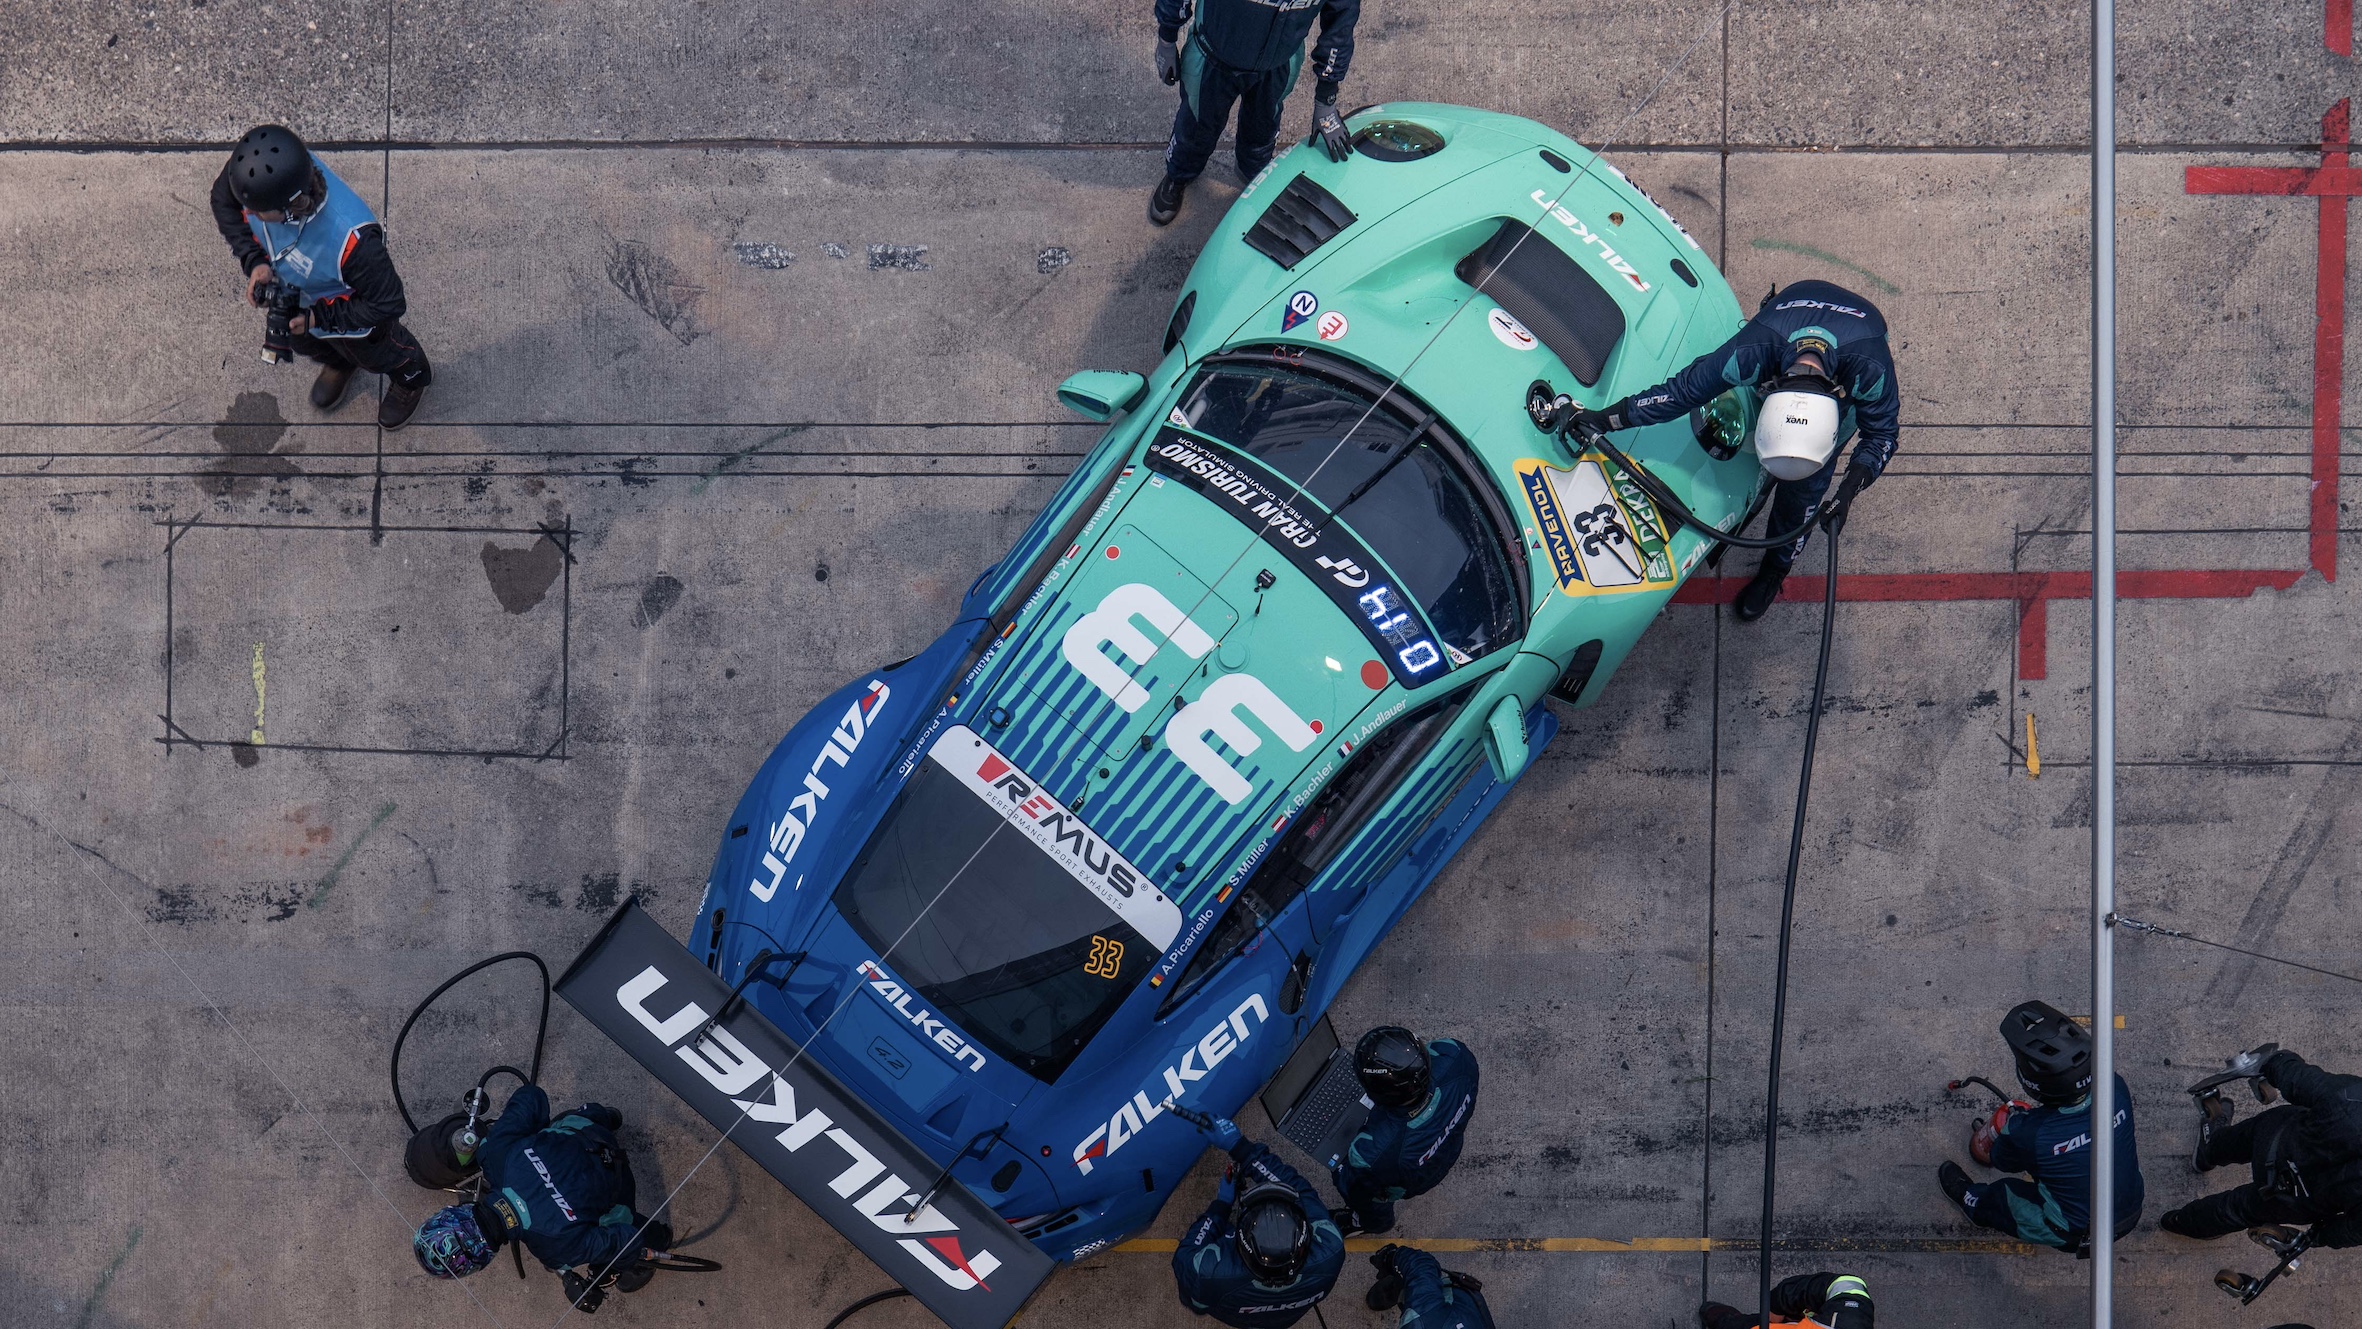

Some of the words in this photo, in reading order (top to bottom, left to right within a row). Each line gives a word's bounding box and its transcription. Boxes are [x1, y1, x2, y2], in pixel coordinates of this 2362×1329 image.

[1530, 188, 1651, 293] FALKEN
[1775, 299, 1866, 319] FALKEN
[1785, 415, 1808, 426] uvex
[1159, 443, 1258, 506] TURISMO
[1177, 437, 1235, 472] SIMULATOR
[1235, 470, 1276, 501] DRIVING
[1083, 476, 1127, 538] J.Andlauer
[1251, 501, 1317, 548] GRAN
[1278, 498, 1305, 521] REAL
[1529, 474, 1576, 576] RAVENOL
[1573, 503, 1626, 557] 33
[1613, 469, 1662, 543] DEKRA
[1021, 558, 1070, 616] K.Bachler
[965, 638, 1004, 686] S.Müller
[1063, 583, 1317, 805] 33
[1351, 698, 1407, 747] J.Andlauer
[898, 706, 949, 774] A.Picariello
[749, 678, 891, 903] FALKEN
[1283, 760, 1334, 819] K.Bachler
[986, 791, 1047, 846] PERFORMANCE
[1049, 844, 1078, 870] SPORT
[1079, 869, 1124, 911] EXHAUSTS
[1229, 837, 1269, 887] S.Müller
[1084, 935, 1124, 979] 33
[1161, 908, 1214, 976] A.Picariello
[856, 959, 986, 1073] FALKEN
[1069, 993, 1269, 1177] FALKEN
[616, 964, 1002, 1293] FALKEN
[1419, 1094, 1470, 1166] FALKEN
[524, 1147, 576, 1222] FALKEN
[1238, 1290, 1325, 1314] FALKEN
